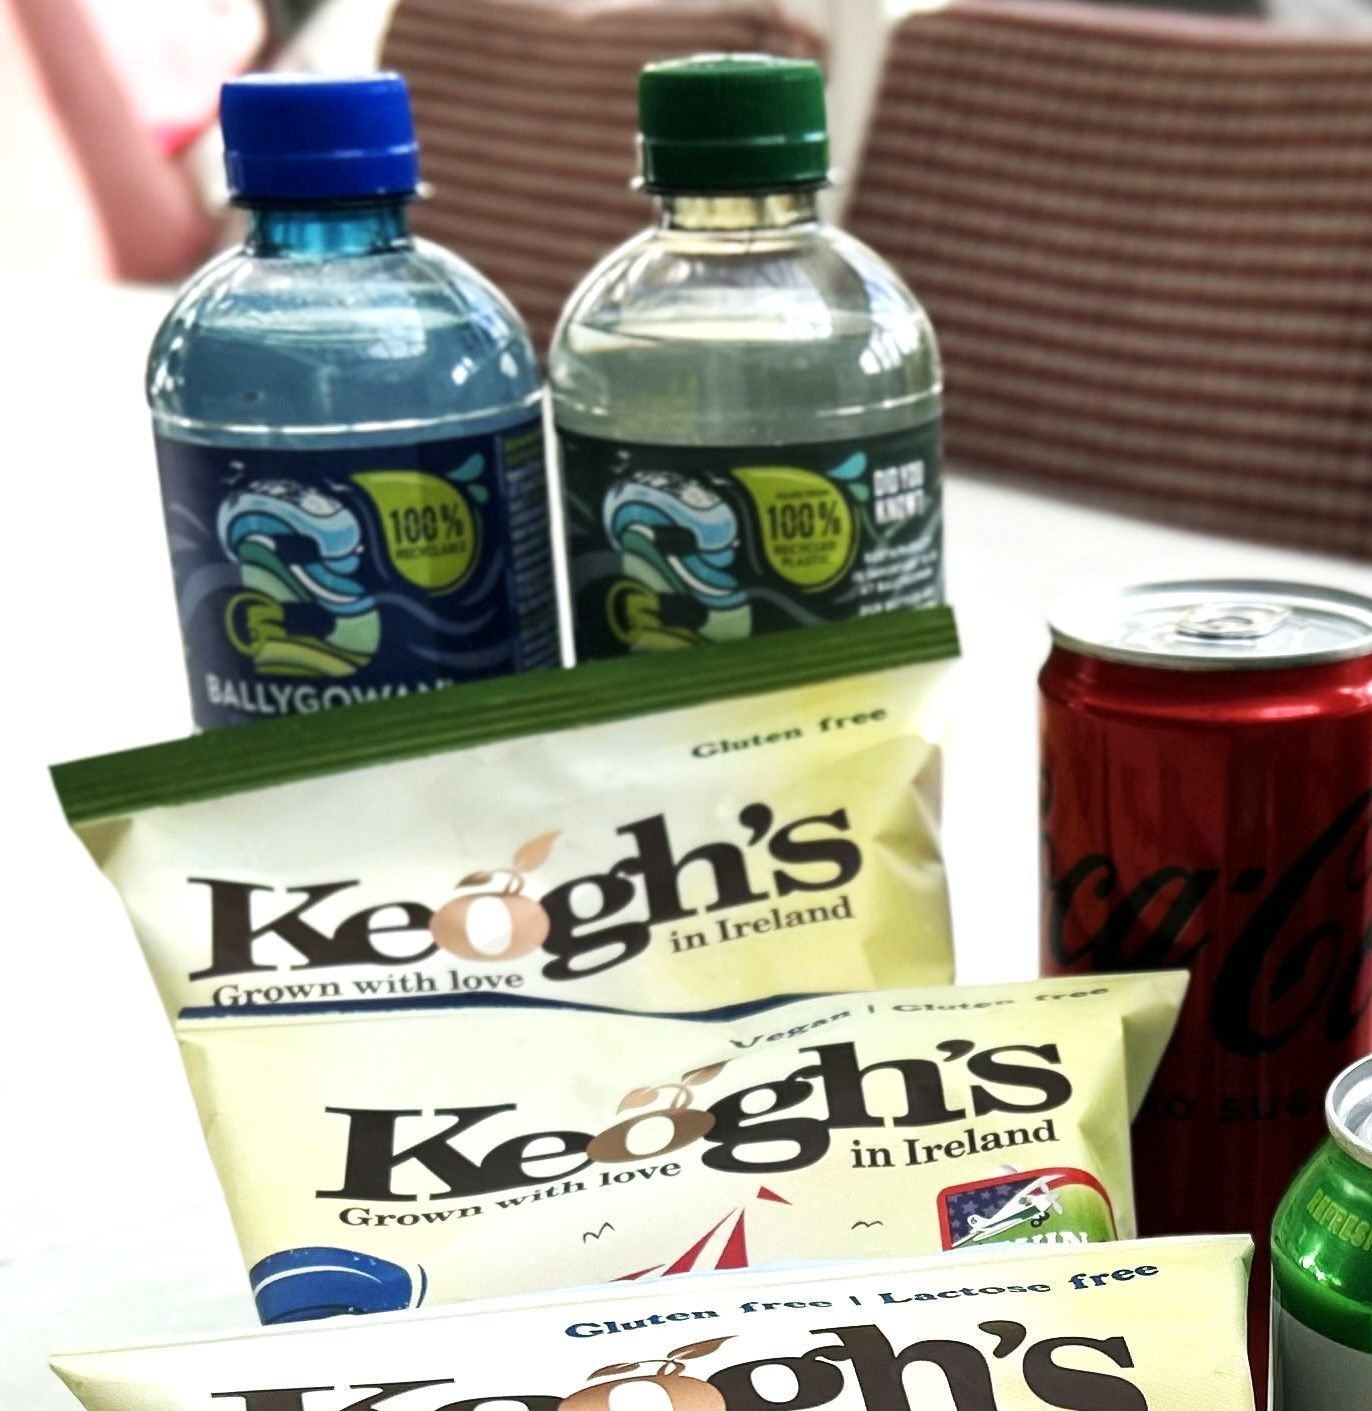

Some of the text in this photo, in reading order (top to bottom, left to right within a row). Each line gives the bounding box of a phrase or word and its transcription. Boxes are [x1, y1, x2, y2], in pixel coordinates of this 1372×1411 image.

[390, 503, 464, 545] 100%
[767, 500, 842, 541] 100%
[781, 555, 832, 567] PLASTIC
[691, 707, 889, 760] Gluten free
[187, 802, 863, 982] Keogh's
[670, 895, 855, 954] in Ireland
[212, 966, 525, 1010] Grown with love
[729, 1008, 853, 1050] Vegan
[890, 997, 1016, 1015] Gluten
[1034, 985, 1110, 1006] free
[314, 1037, 1073, 1204] Keogh's
[850, 1119, 1060, 1170] in Ireland
[337, 1159, 682, 1230] Grown with love
[564, 1304, 719, 1343] Gluten
[739, 1295, 833, 1318] free
[878, 1282, 1052, 1307] Lactose
[1068, 1260, 1160, 1292] free
